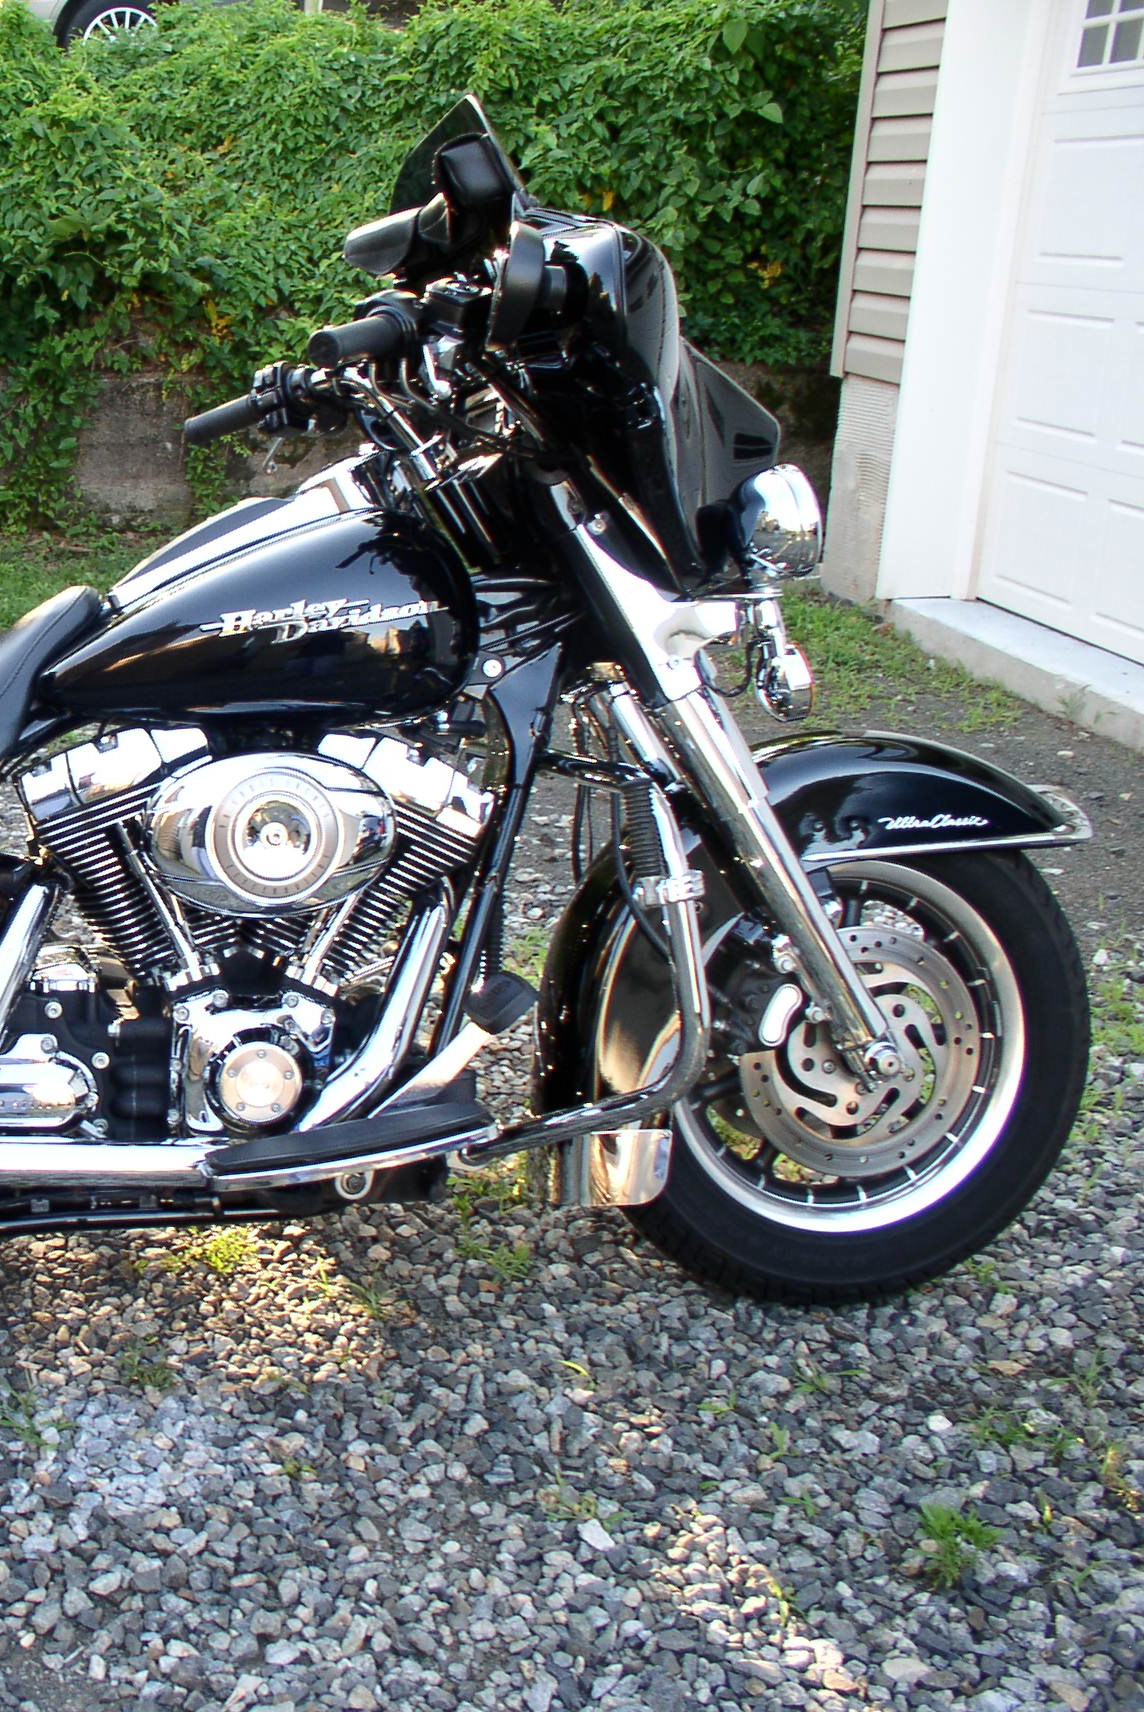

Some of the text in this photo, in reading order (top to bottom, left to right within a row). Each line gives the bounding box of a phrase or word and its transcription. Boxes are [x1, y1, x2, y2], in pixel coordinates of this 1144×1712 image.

[218, 599, 366, 637] Harley
[266, 600, 440, 644] Davidson
[877, 813, 989, 830] Ultra Classic
